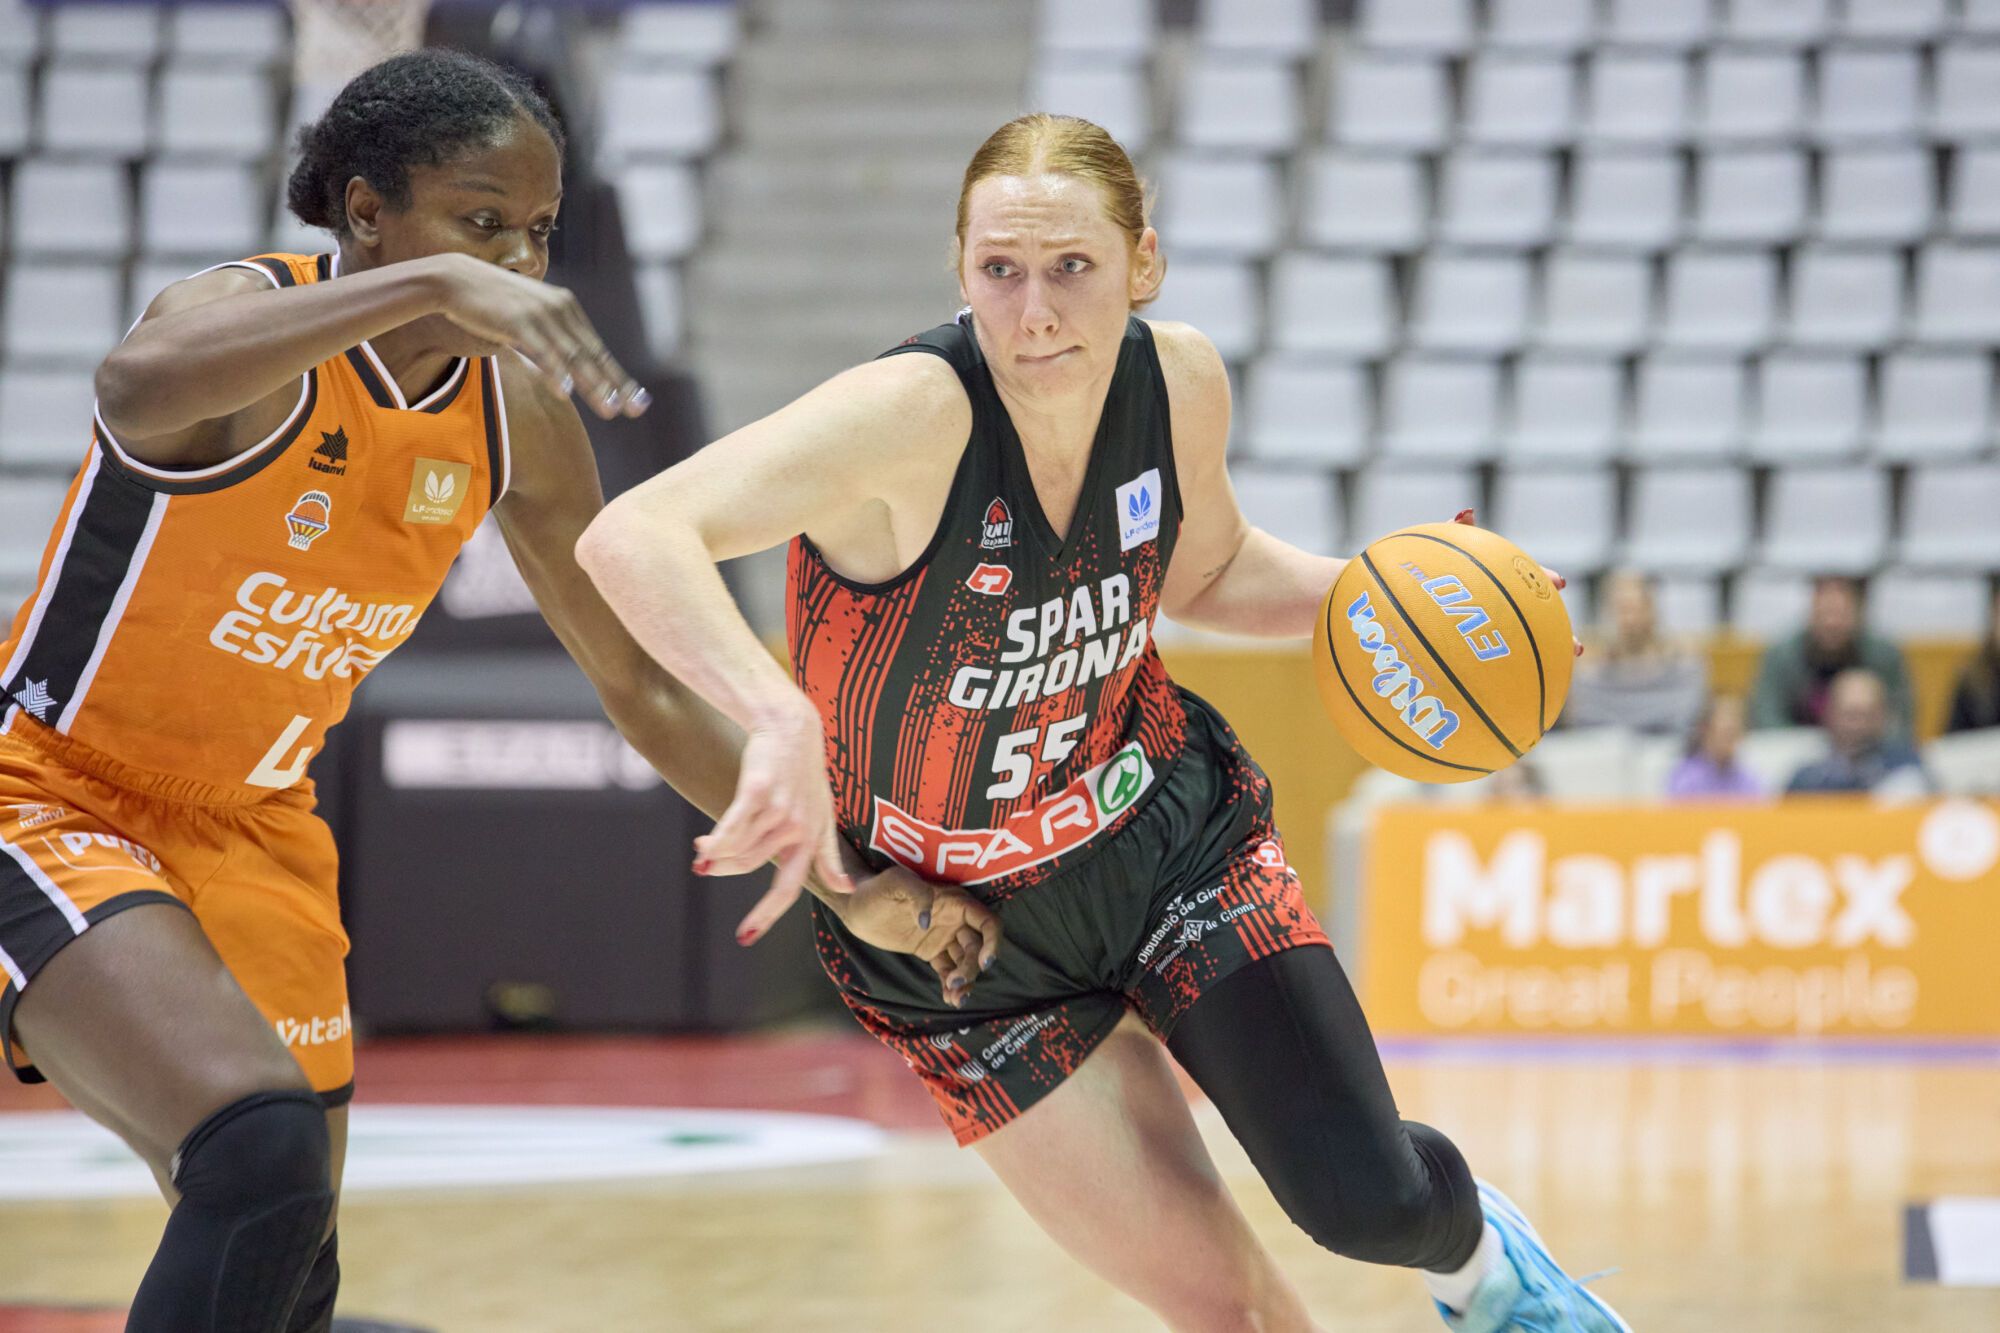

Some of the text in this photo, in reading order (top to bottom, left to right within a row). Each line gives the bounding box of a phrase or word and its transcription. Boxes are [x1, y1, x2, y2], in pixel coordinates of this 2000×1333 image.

[308, 457, 346, 476] luanvi
[986, 522, 1009, 539] UNI
[236, 571, 413, 640] Cultura
[1000, 573, 1130, 664] SPAR
[1421, 574, 1510, 662] EVO
[948, 618, 1150, 710] GIRONA
[1347, 591, 1460, 750] Wilson
[882, 794, 1092, 874] SPAR
[1205, 920, 1218, 931] de
[1220, 902, 1256, 922] Girona
[1421, 828, 1915, 948] Marlex
[1138, 912, 1179, 964] Diputació
[1179, 901, 1195, 916] de
[1419, 948, 1919, 1037] Great People
[982, 1014, 1037, 1060] Generalitat
[991, 1054, 1006, 1070] de
